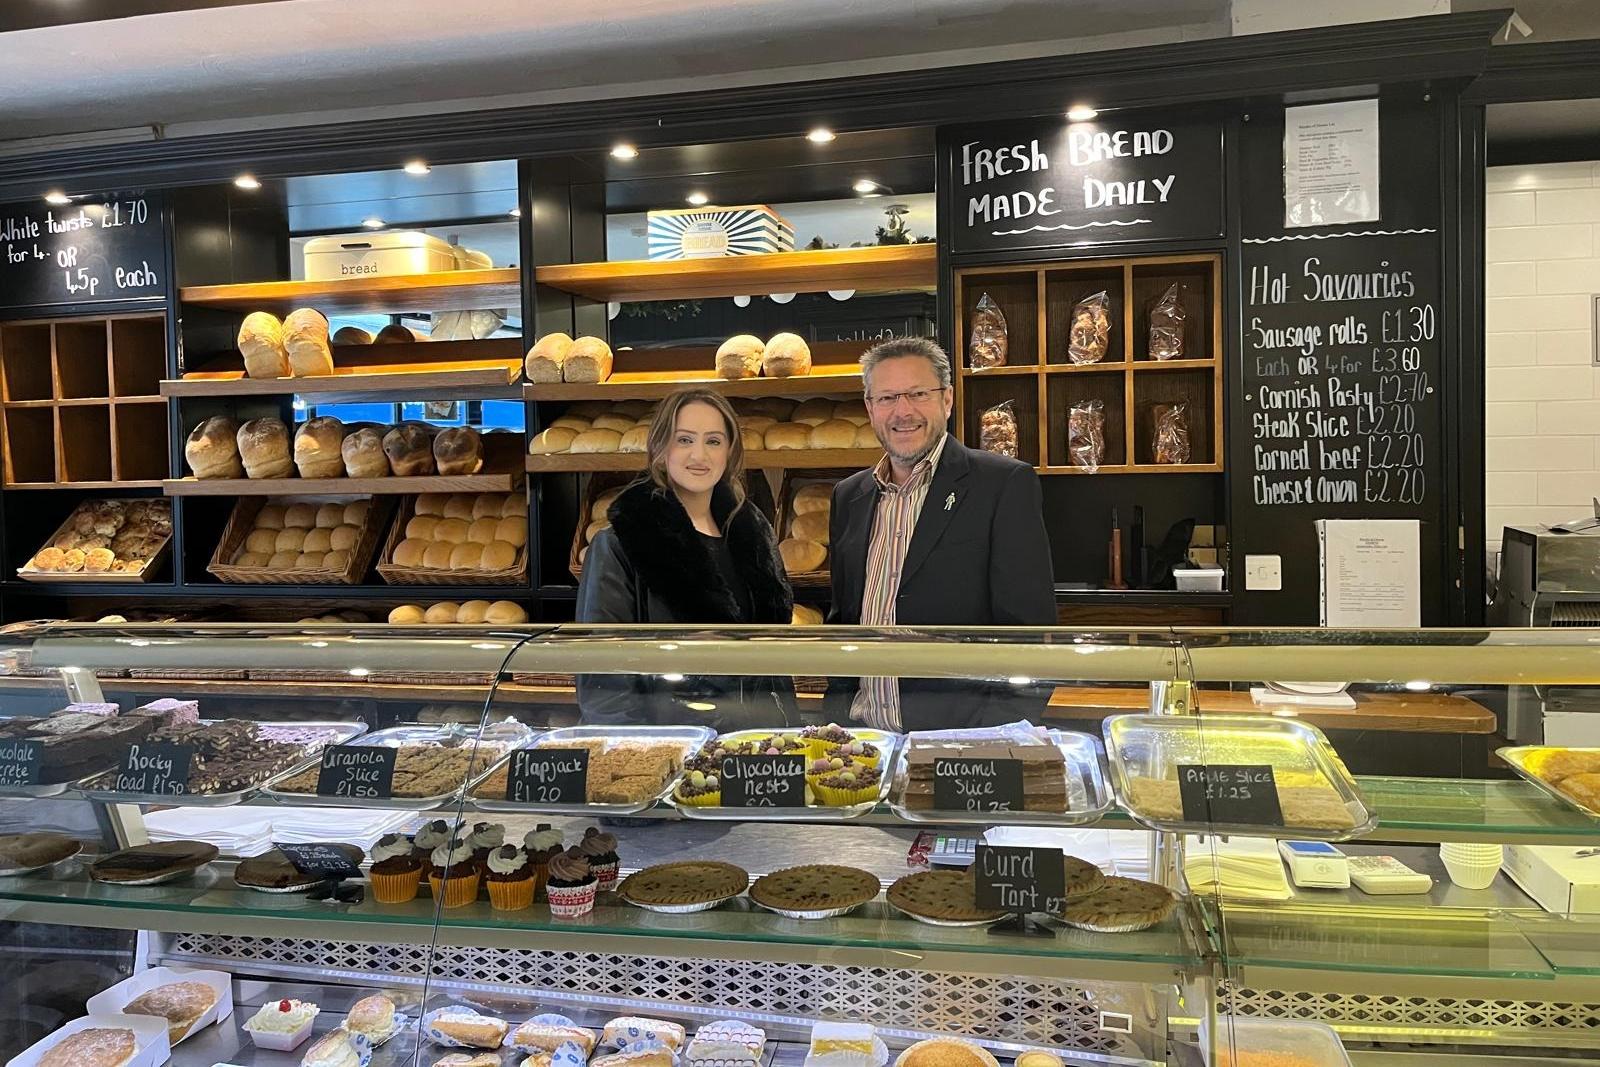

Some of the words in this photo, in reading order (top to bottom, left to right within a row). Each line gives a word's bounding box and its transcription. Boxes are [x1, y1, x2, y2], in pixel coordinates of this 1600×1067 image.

[1068, 128, 1174, 167] BREAD
[968, 187, 1062, 227] MADE
[1083, 174, 1176, 209] DAILY
[0, 216, 40, 241] White
[45, 209, 94, 234] twists
[101, 199, 148, 228] £1.70
[7, 244, 29, 264] for
[57, 246, 78, 268] OR
[341, 262, 378, 275] bread
[65, 267, 99, 295] 45p
[115, 261, 157, 289] each
[1249, 265, 1291, 305] Hot
[1303, 257, 1415, 301] Savouries
[1251, 316, 1323, 356] Sausage
[1381, 303, 1435, 343] £1.30
[1256, 356, 1290, 377] Each
[1298, 355, 1319, 376] OR
[1340, 355, 1363, 374] for
[1372, 346, 1421, 373] £3.60
[1259, 380, 1321, 409] Cornish
[1328, 376, 1375, 423] Pasty
[1305, 410, 1350, 438] Slice
[1254, 440, 1311, 471] Corned
[1319, 439, 1361, 470] beef
[1368, 433, 1424, 469] £2.20
[128, 745, 172, 778] Rocky
[323, 746, 385, 769] Granola
[722, 757, 804, 779] Chocolate
[936, 760, 996, 777] Caramel
[116, 772, 146, 791] road
[345, 767, 380, 782] Slice
[744, 778, 790, 795] nests
[954, 778, 995, 795] Slice
[1205, 784, 1252, 799] £1.25
[983, 848, 1034, 878] Curd
[991, 883, 1039, 908] Tart
